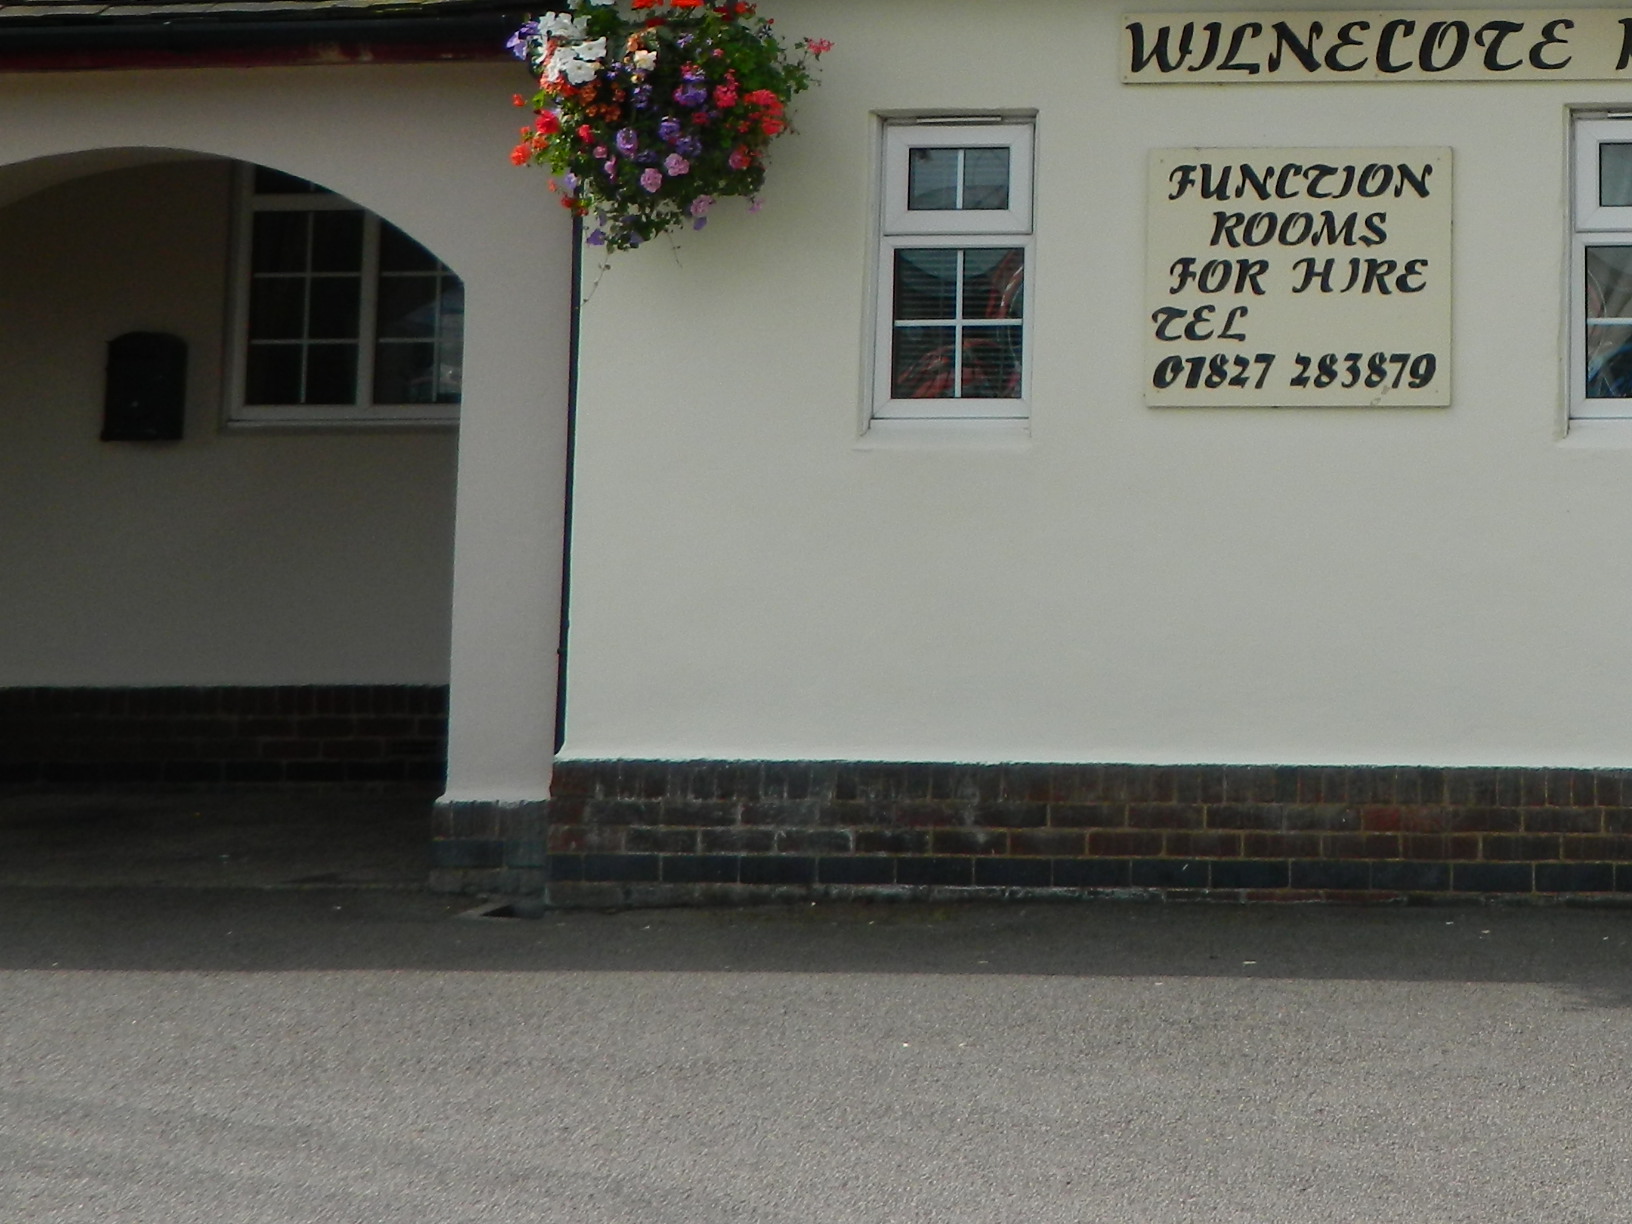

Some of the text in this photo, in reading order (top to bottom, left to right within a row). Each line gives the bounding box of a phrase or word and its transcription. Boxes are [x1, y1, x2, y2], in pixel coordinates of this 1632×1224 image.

[1125, 19, 1575, 74] WILNECOTE
[1168, 163, 1433, 201] FUNCTION
[1209, 210, 1388, 248] ROOMS
[1169, 257, 1429, 295] FOR HIRE
[1151, 304, 1248, 342] TEL
[1152, 352, 1437, 389] 01827 283879
